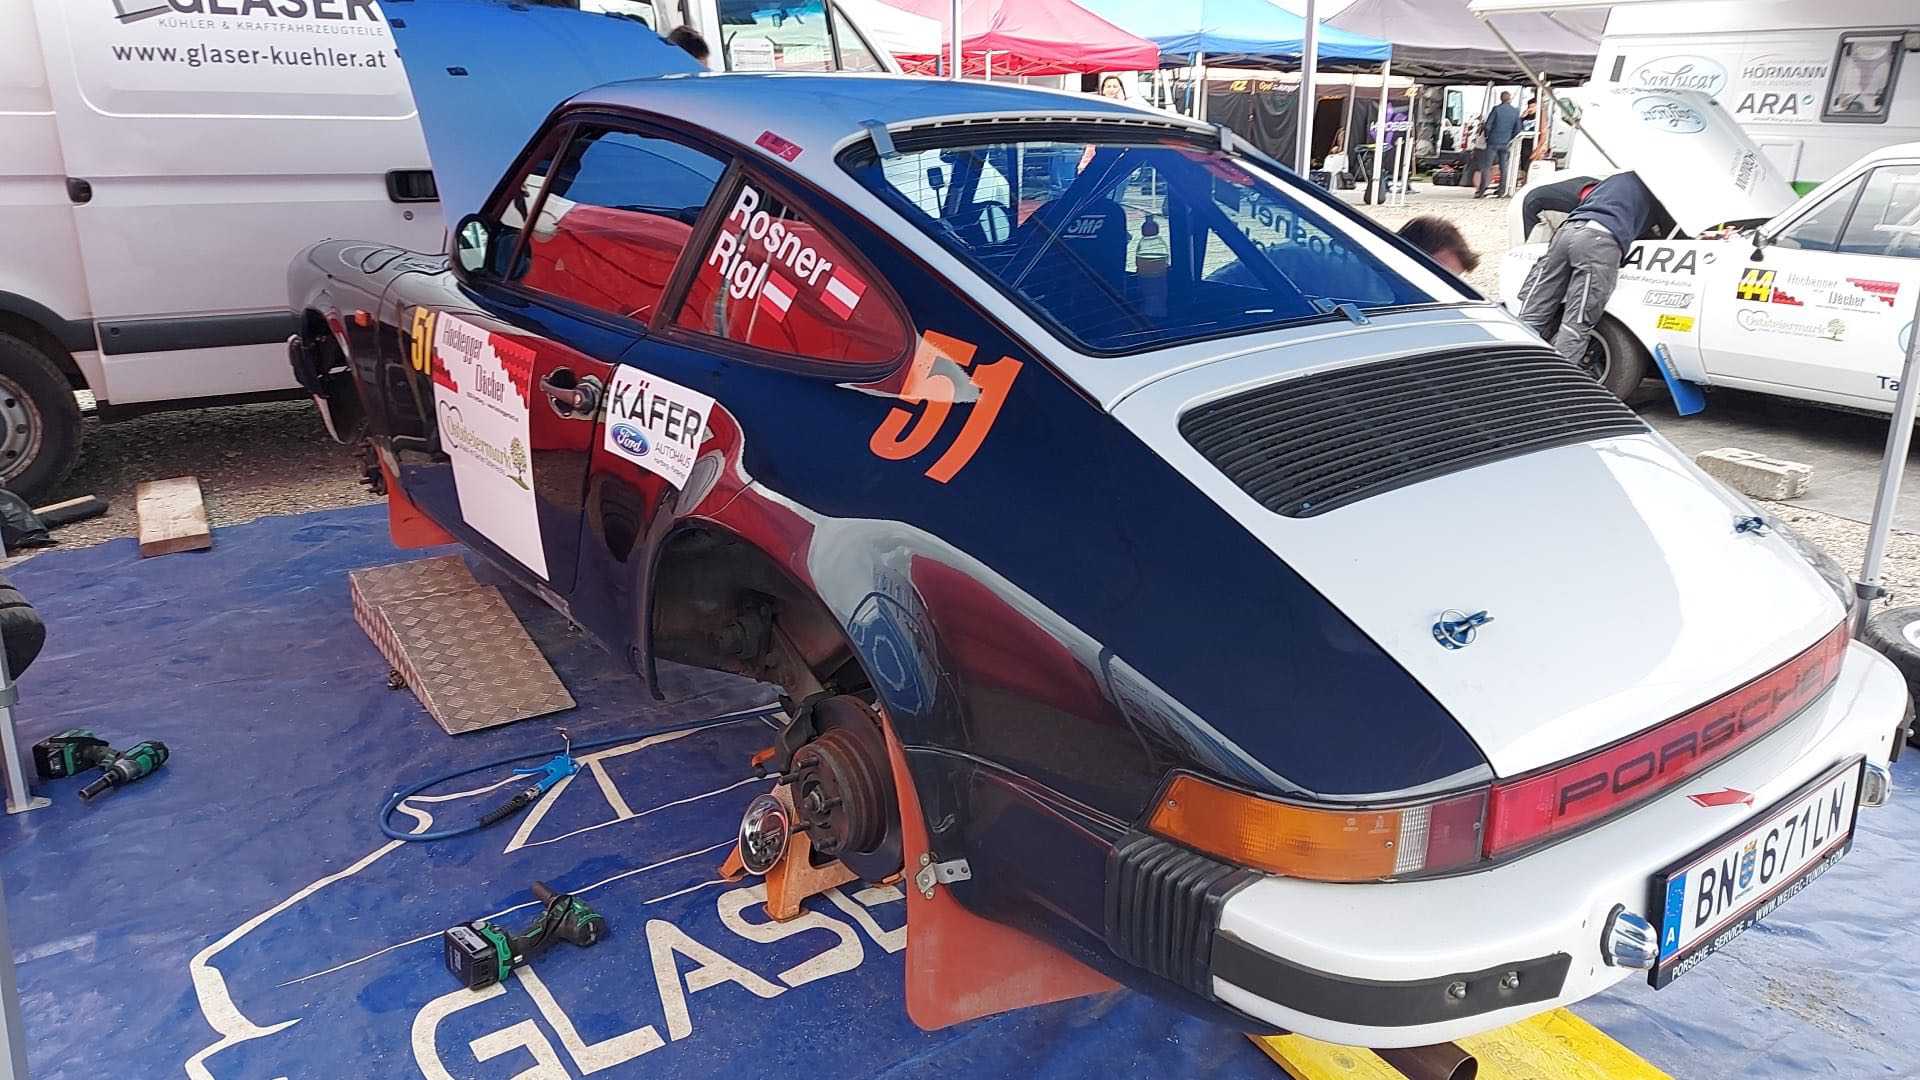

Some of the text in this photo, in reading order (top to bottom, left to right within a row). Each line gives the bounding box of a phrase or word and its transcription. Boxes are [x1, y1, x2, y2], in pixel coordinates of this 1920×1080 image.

[158, 18, 384, 36] KÜHLER & KRAFTFAHRZEUGTEILE
[112, 44, 387, 68] www.glaser-kuehler.at
[1735, 92, 1797, 115] ARA
[730, 185, 833, 286] Rosner
[1067, 219, 1104, 234] OMP
[709, 230, 769, 300] Rigl
[1619, 245, 1697, 275] ARA
[1737, 269, 1776, 302] 44
[411, 306, 436, 375] 51
[611, 379, 702, 450] KÄFER
[869, 329, 1025, 484] 51
[612, 427, 643, 453] Ford
[1558, 661, 1824, 817] PORSCHE
[1695, 780, 1847, 929] BN 671LN
[1665, 926, 1677, 947] A
[1671, 944, 1710, 981] PORSCHE
[1713, 920, 1745, 952] SERVICE
